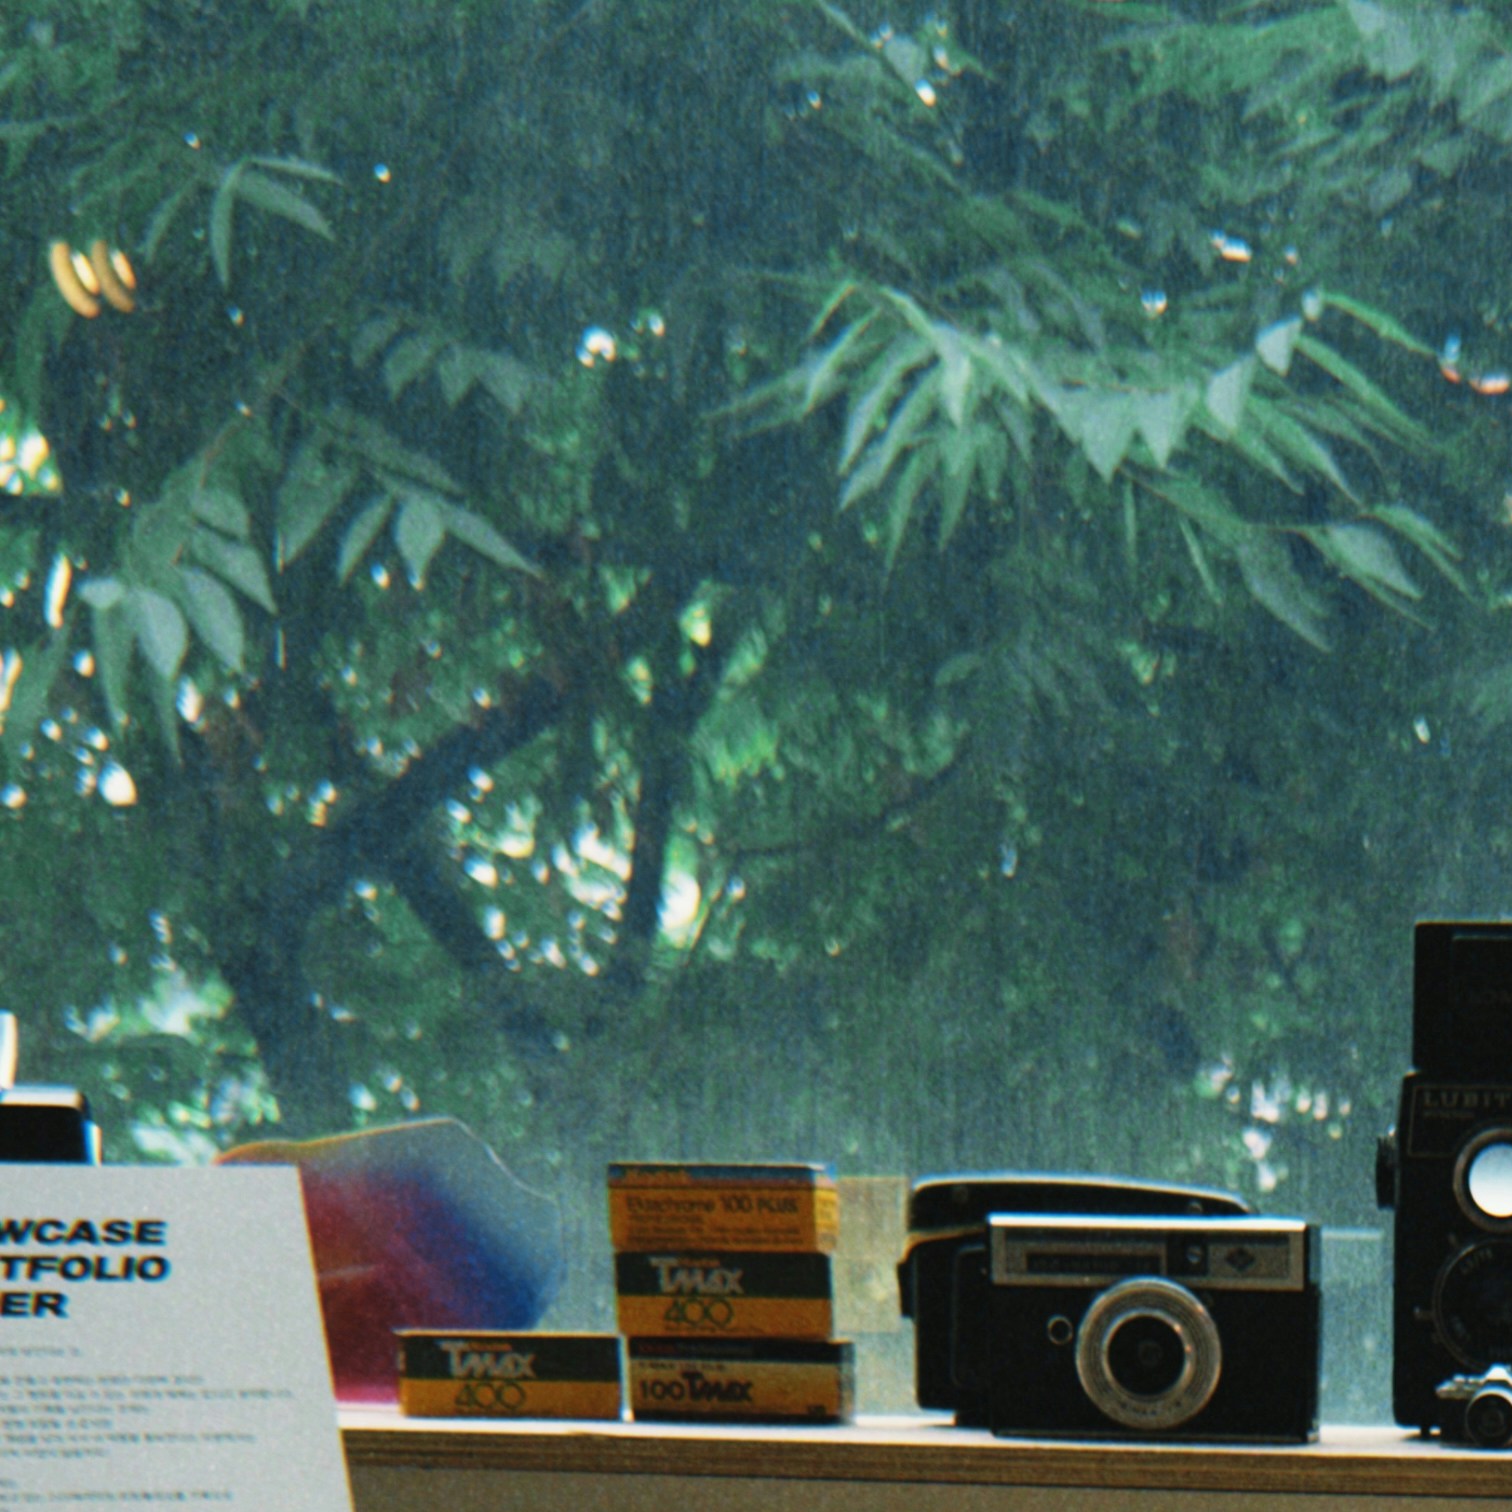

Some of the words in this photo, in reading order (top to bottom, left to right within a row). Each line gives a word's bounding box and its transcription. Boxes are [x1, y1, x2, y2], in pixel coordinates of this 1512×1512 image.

[719, 1194, 752, 1213] 100
[664, 1295, 734, 1327] 400
[455, 1380, 526, 1409] 400
